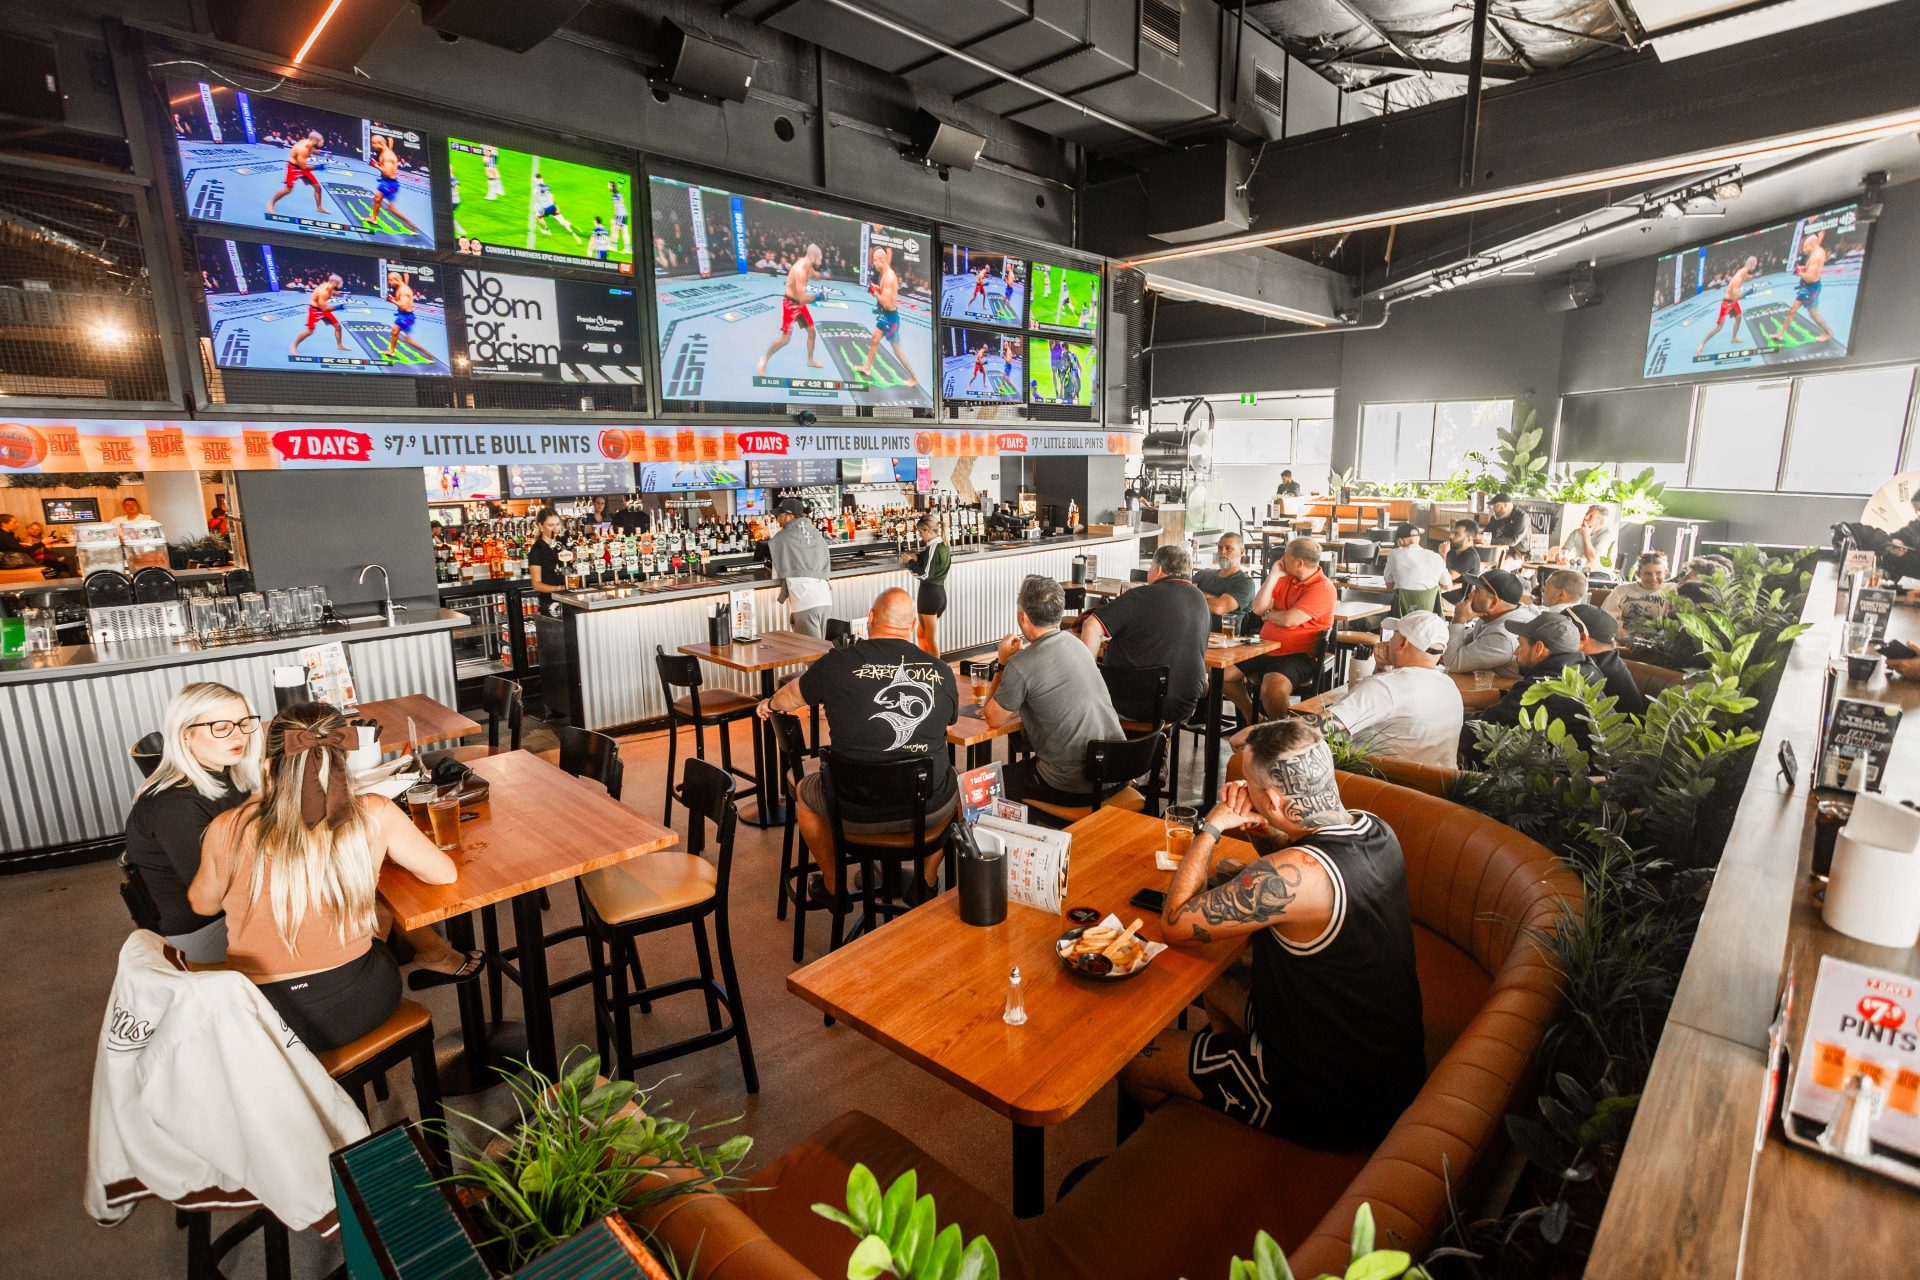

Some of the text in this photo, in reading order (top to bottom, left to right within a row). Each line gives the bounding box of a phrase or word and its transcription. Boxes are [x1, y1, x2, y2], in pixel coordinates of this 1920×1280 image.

[734, 212, 747, 261] BUD LIGHT
[485, 246, 511, 255] COWBOYS
[516, 250, 542, 260] PANTHERS
[462, 269, 503, 298] No
[464, 294, 542, 320] room
[465, 314, 506, 341] for
[576, 315, 597, 323] Premier
[586, 324, 616, 332] Productions
[468, 333, 560, 364] racism
[792, 379, 806, 387] UFC
[288, 436, 360, 456] 7 DAYS
[384, 434, 591, 456] $7.9 LITTLE BULL PINTS
[746, 436, 783, 451] 7 DAYS
[795, 435, 910, 451] $7.9 LITTLE BULL PINTS
[1001, 438, 1024, 449] 7 DAYS
[1043, 437, 1066, 449] LITTLE
[1067, 438, 1083, 449] BULL
[1085, 438, 1104, 449] PINTS
[1529, 512, 1552, 534] NION
[1840, 1015, 1918, 1052] PINTS
